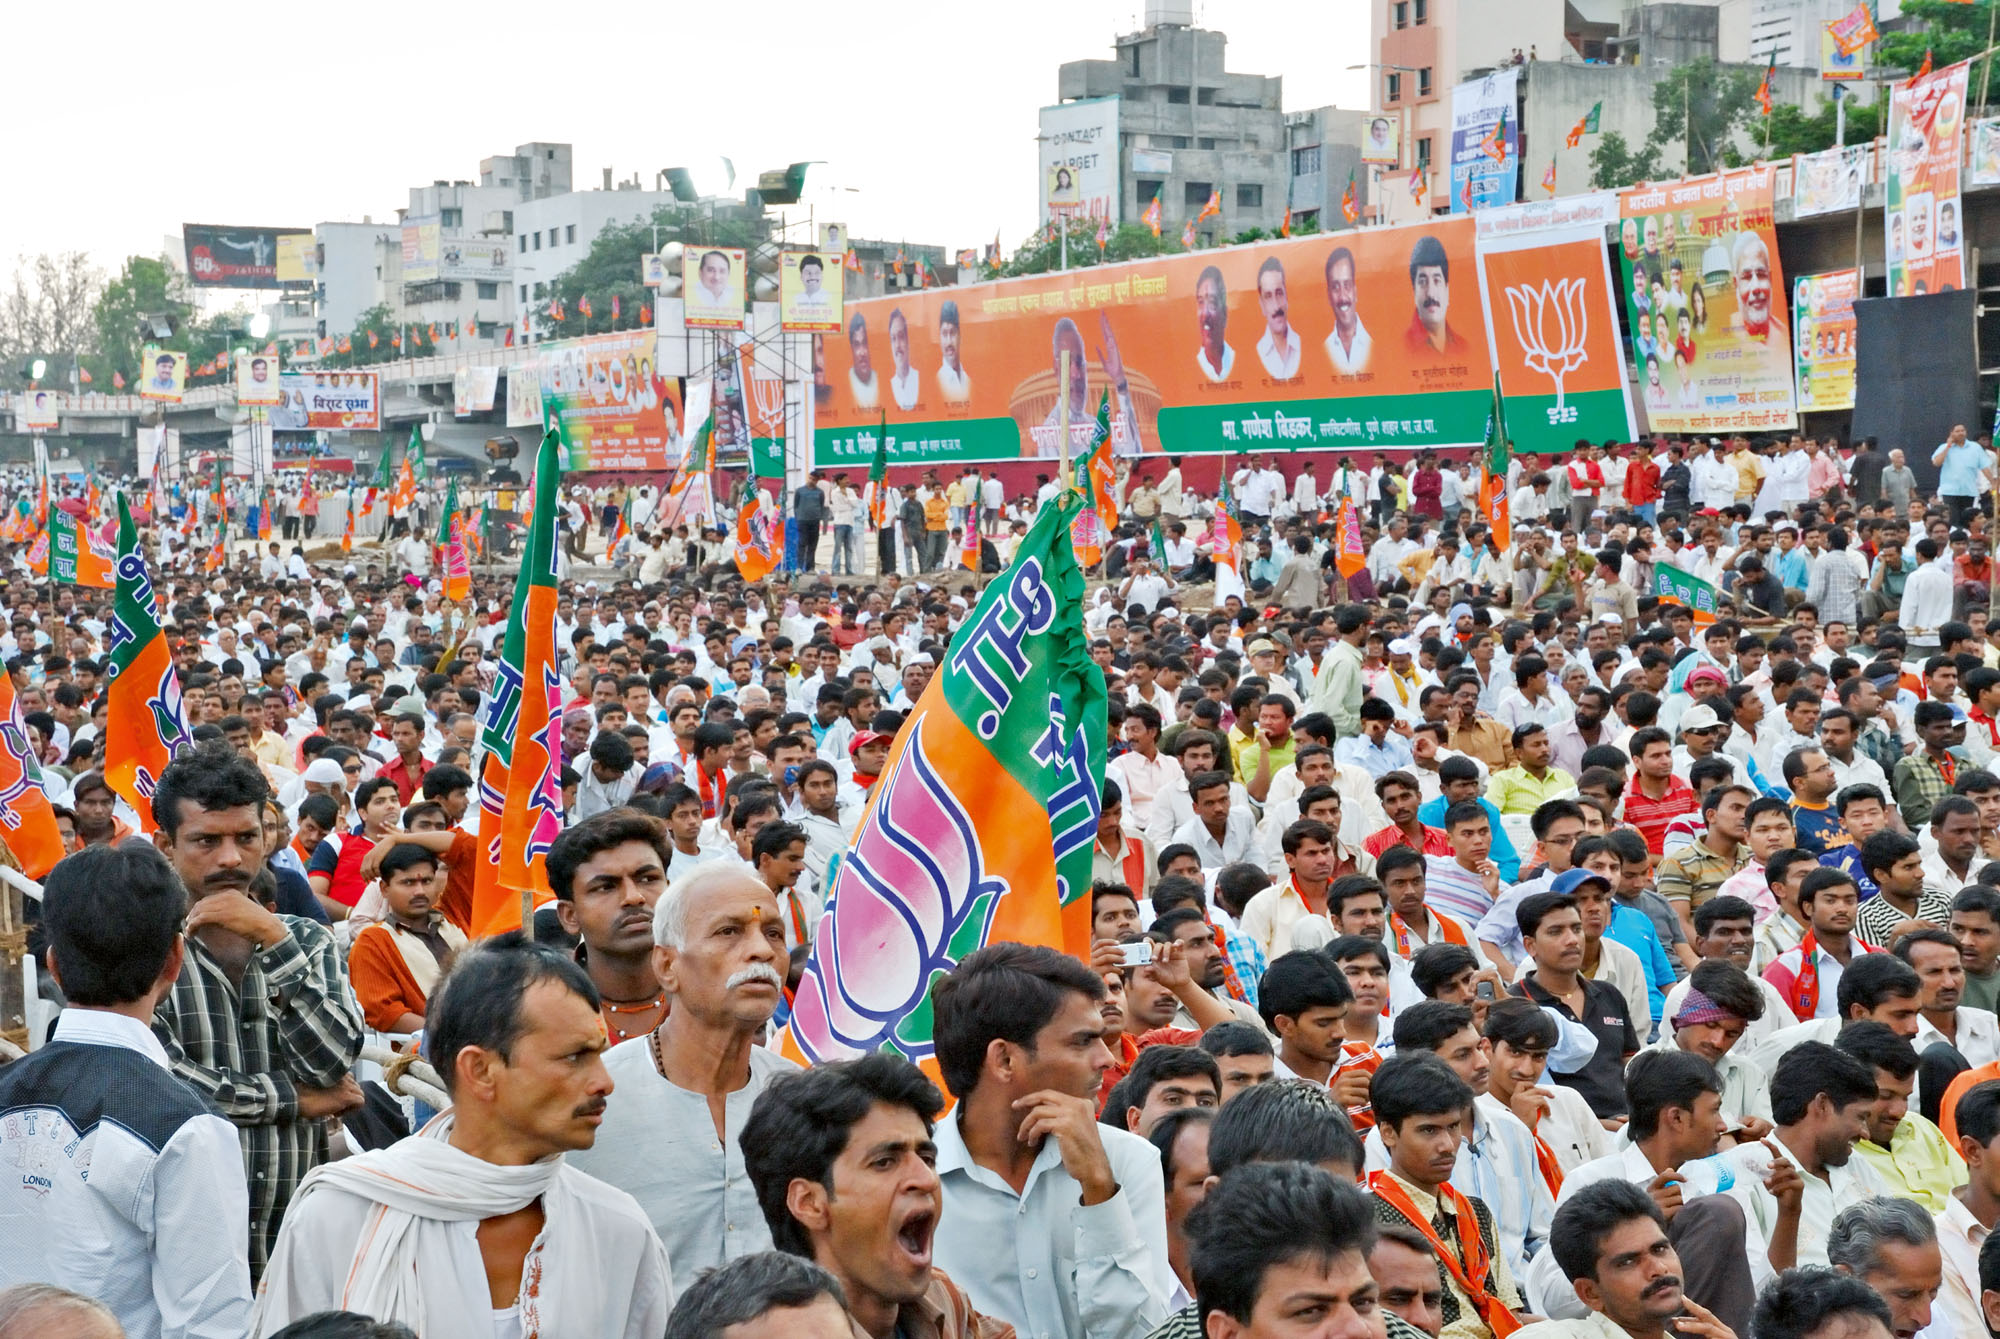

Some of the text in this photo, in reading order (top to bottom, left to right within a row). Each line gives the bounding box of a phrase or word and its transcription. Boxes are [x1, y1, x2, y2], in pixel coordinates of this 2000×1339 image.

[1053, 126, 1103, 146] CONTACT
[1629, 167, 1771, 210] भारतीय जनता पार्टी युवा मोर्चा
[1698, 205, 1772, 238] जाहीर सभा
[313, 395, 369, 412] विराट सभा
[1222, 419, 1240, 441] मा.
[1241, 411, 1273, 440] गणेश
[1275, 410, 1317, 442] बिडकर,
[1366, 416, 1380, 440] पुणे
[1381, 419, 1399, 436] शहर
[1401, 418, 1438, 435] भा.ज.पा.
[22, 1174, 52, 1190] LONDON
